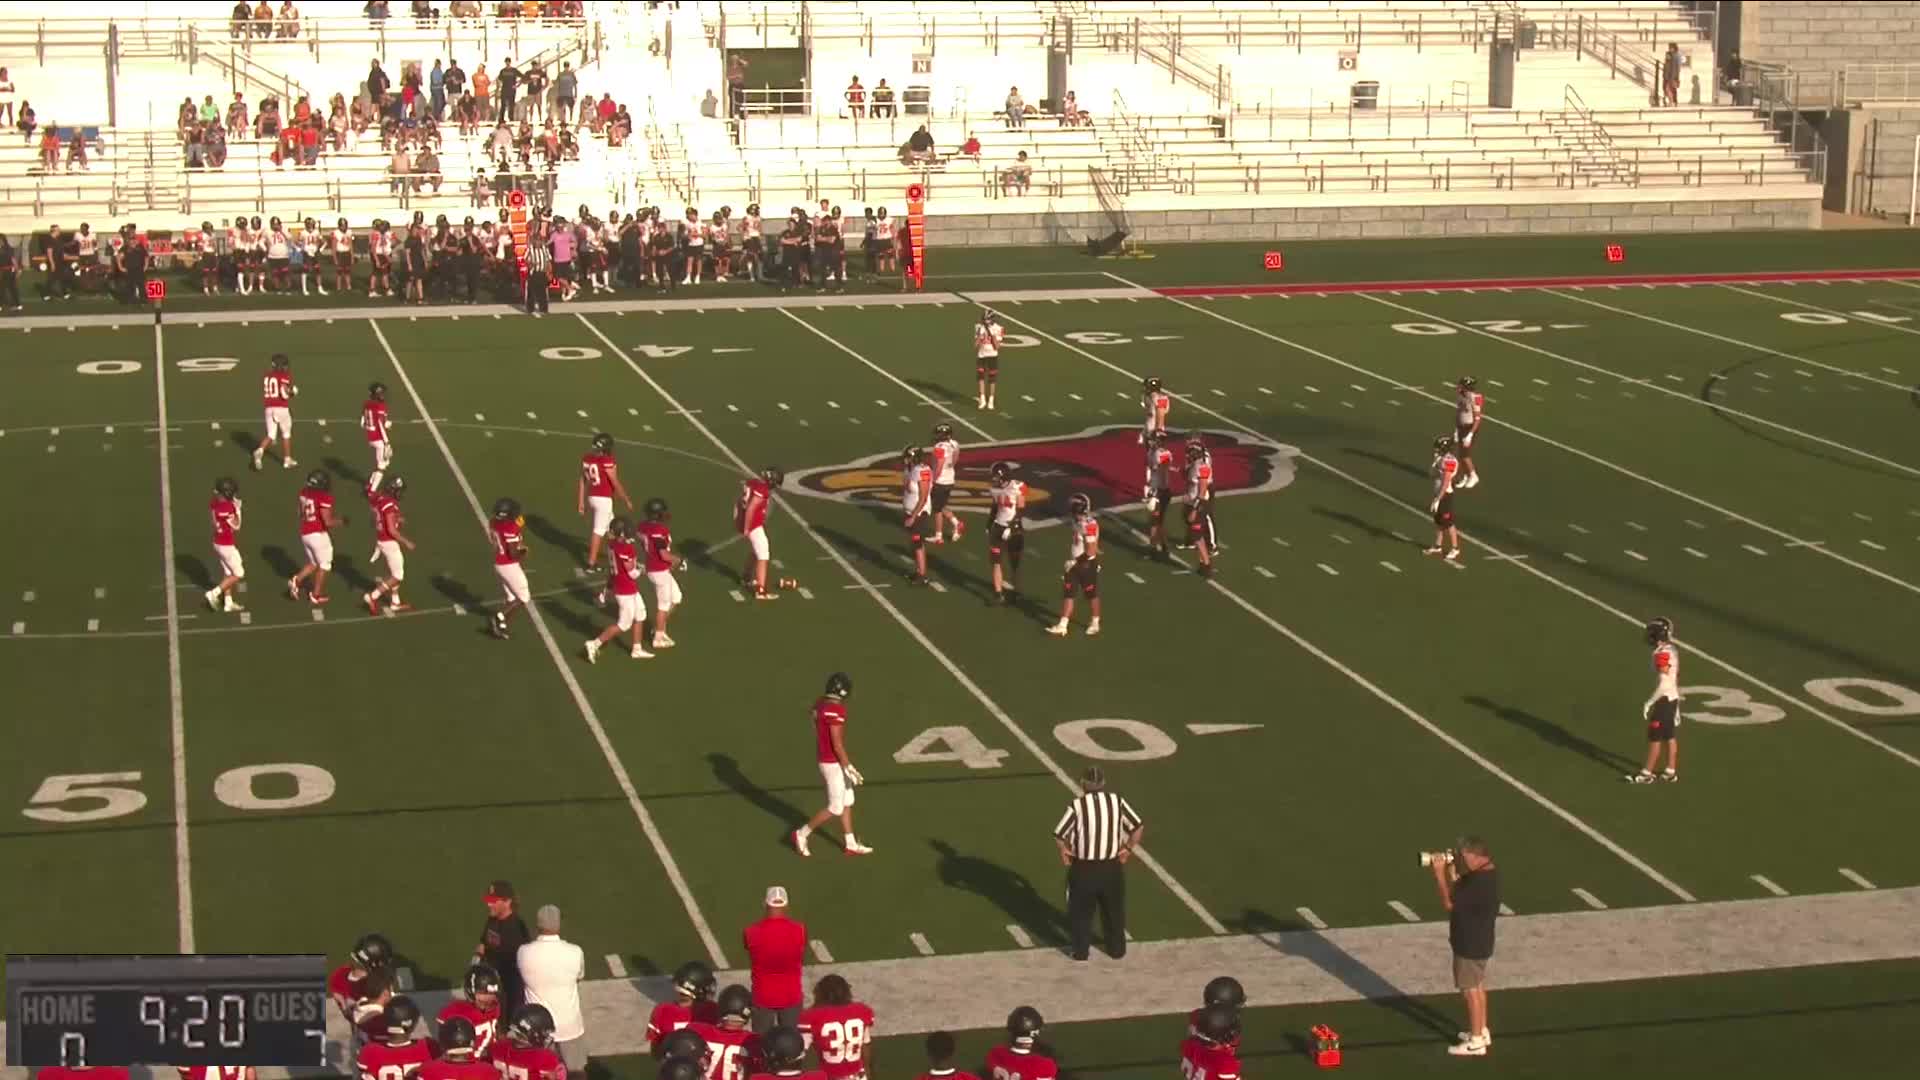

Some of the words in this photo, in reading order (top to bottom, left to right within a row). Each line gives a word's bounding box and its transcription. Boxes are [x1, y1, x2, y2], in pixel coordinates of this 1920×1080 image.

[917, 60, 927, 73] N
[1266, 254, 1280, 266] 20
[148, 282, 162, 296] 50
[892, 718, 1179, 769] 40
[21, 762, 337, 823] 50
[821, 1018, 864, 1064] 38
